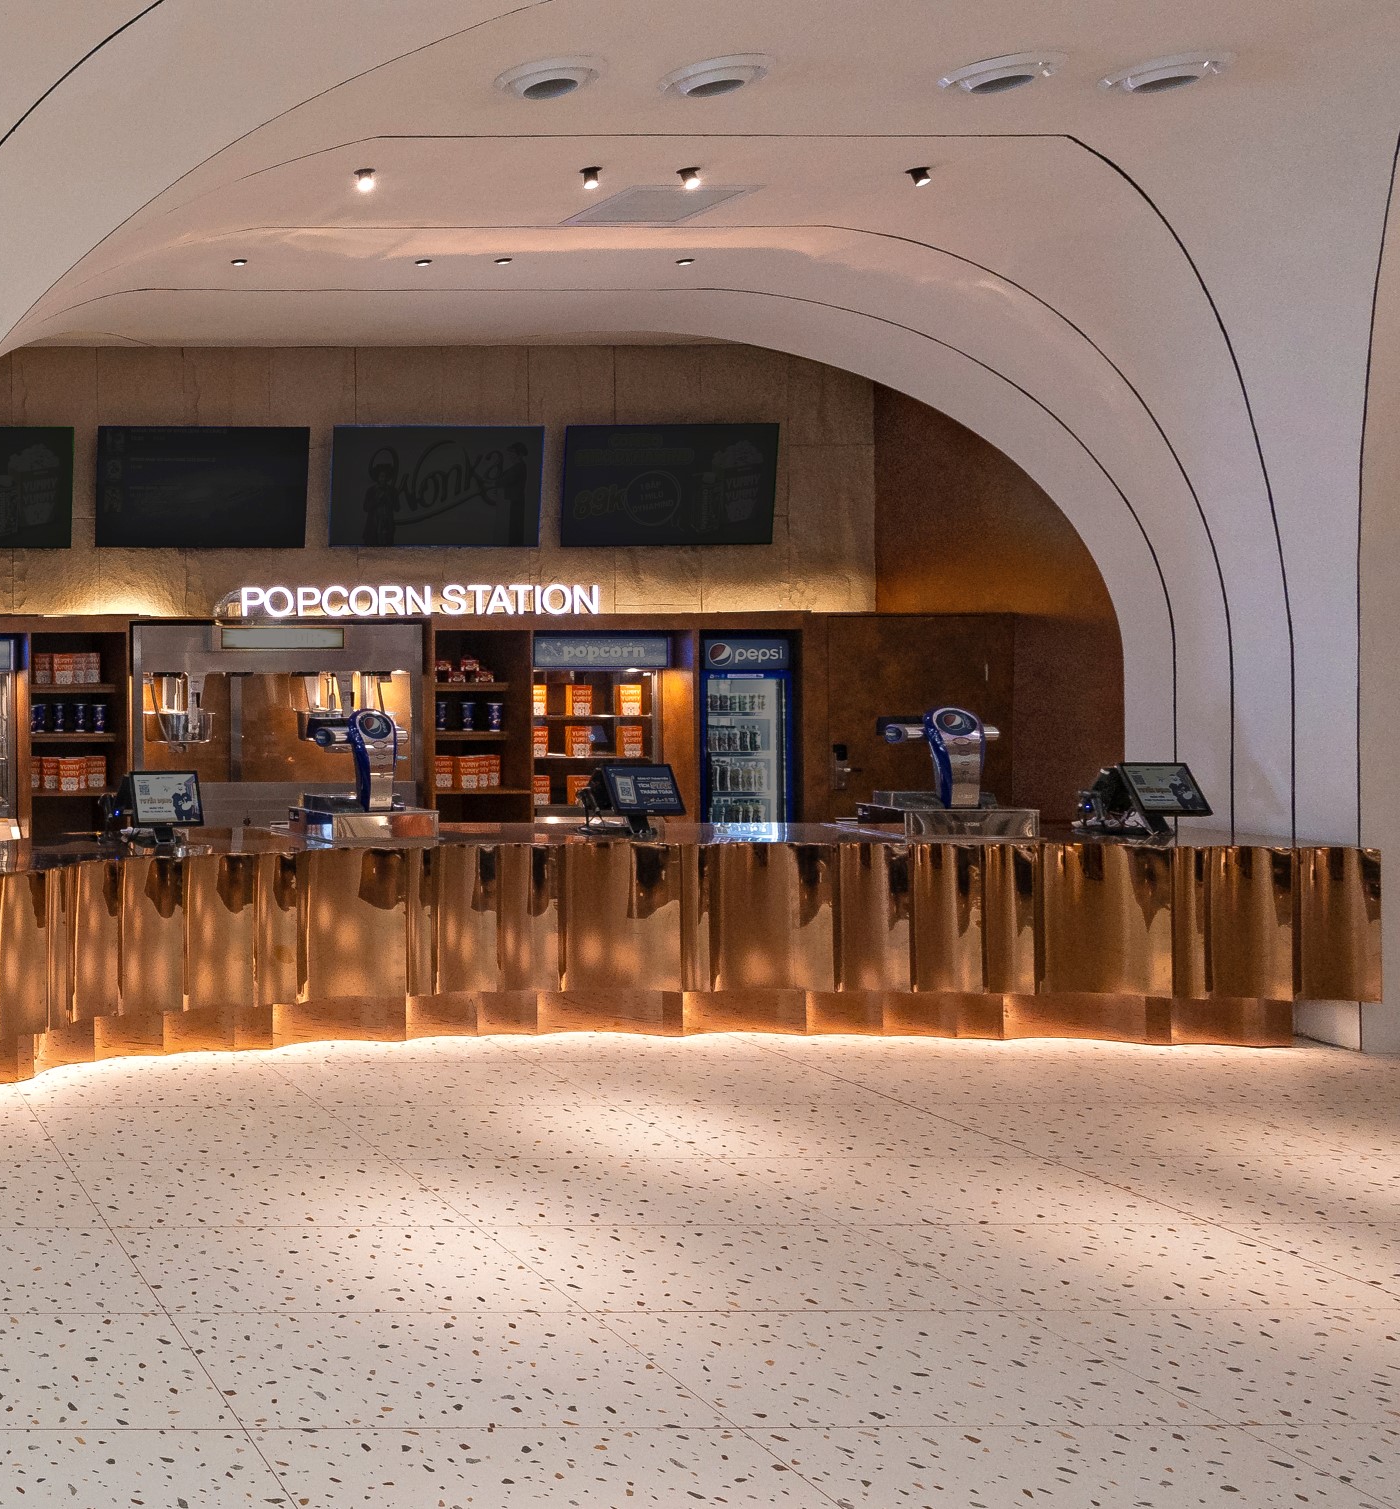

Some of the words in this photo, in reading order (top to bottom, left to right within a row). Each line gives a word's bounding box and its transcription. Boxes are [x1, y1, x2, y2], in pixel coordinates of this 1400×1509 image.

[369, 440, 504, 511] Wonka
[242, 586, 431, 617] POPCORN
[442, 584, 600, 616] STATION
[562, 646, 645, 662] popcorn
[734, 646, 783, 664] pepsi
